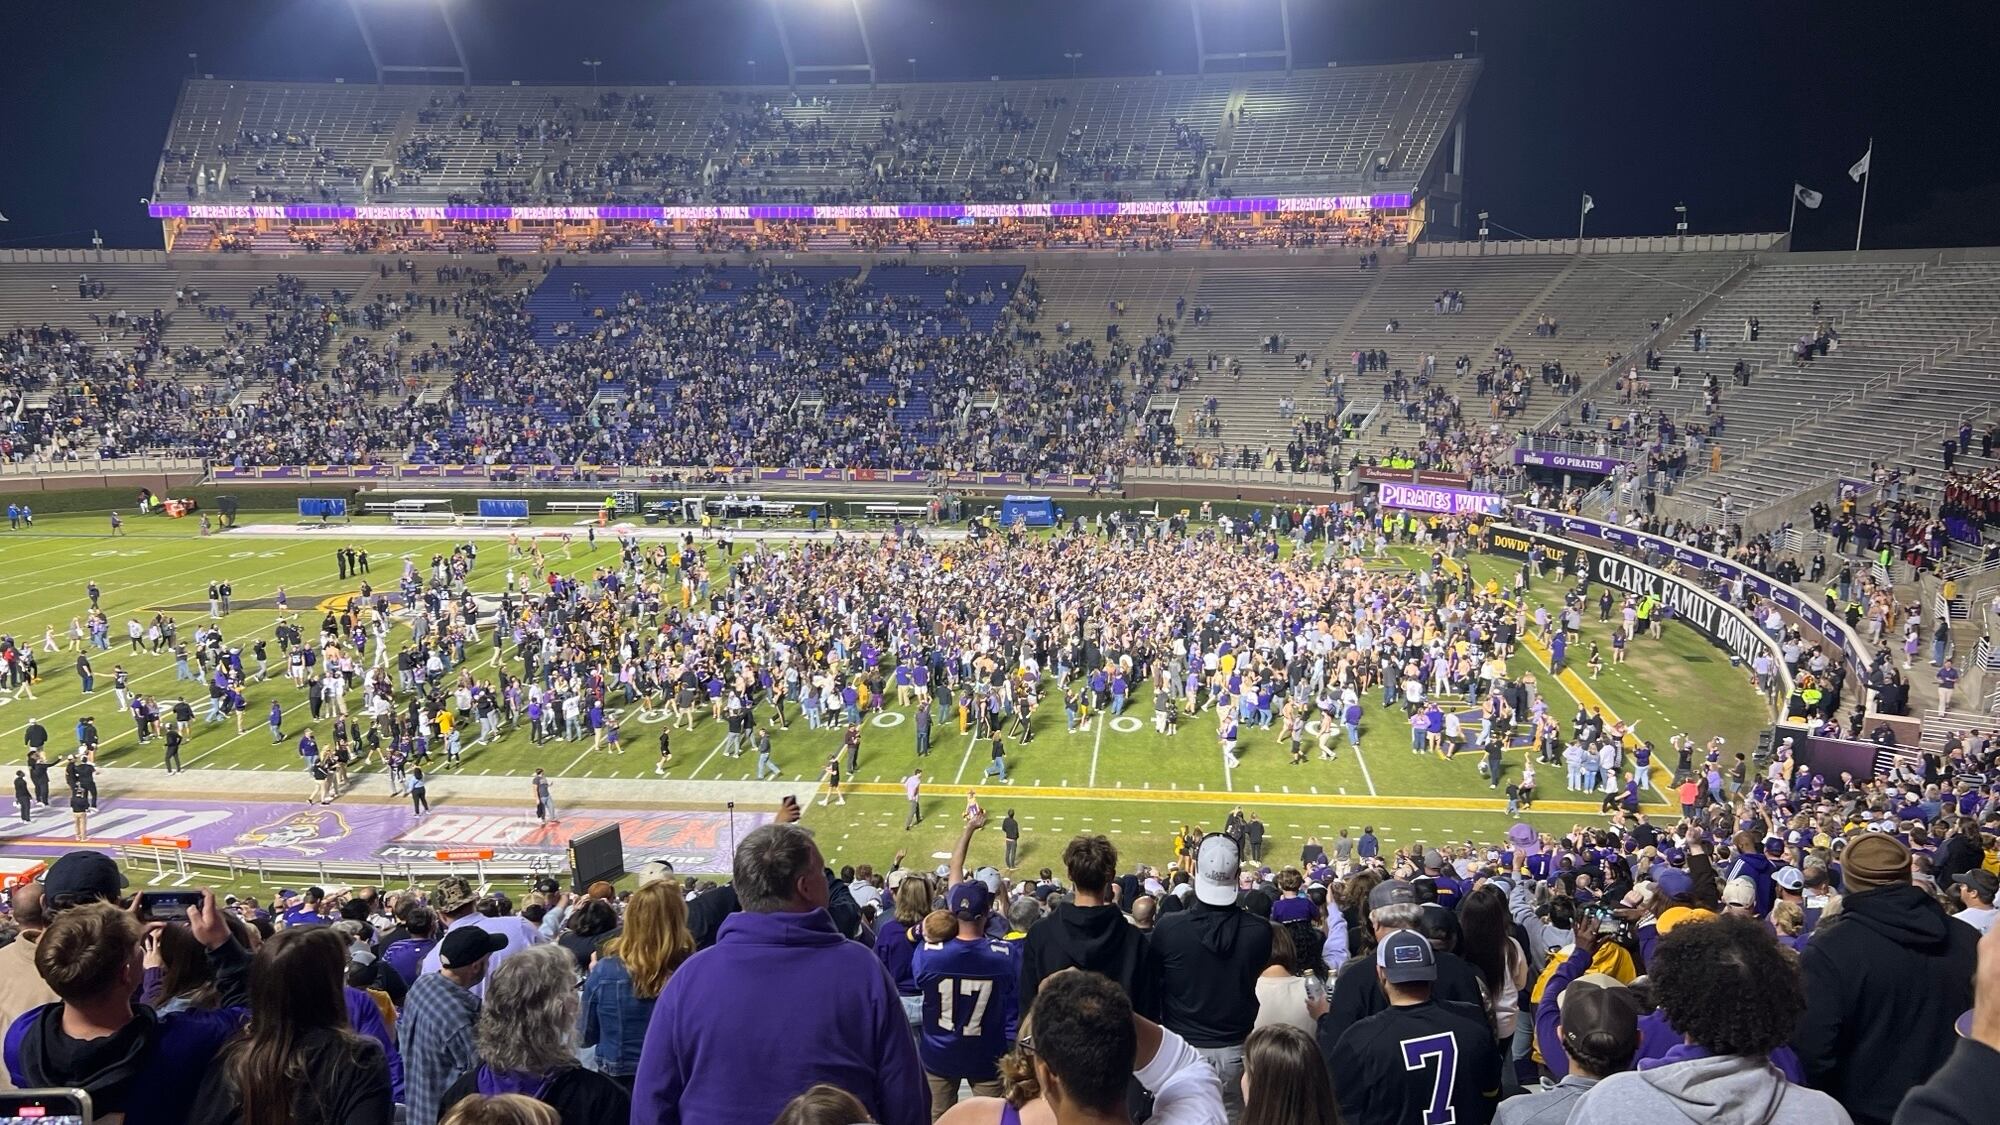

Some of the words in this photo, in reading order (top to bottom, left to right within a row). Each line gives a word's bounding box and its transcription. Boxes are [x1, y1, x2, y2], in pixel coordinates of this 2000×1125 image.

[1118, 201, 1174, 214] PIRATES
[1177, 201, 1207, 214] WIN
[1278, 196, 1336, 210] PIRATES
[1338, 196, 1370, 210] WIN
[188, 205, 251, 218] PIRATES
[252, 205, 285, 218] WIN
[355, 206, 412, 219] PIRATES
[414, 206, 445, 219] WIN
[511, 206, 567, 219] PIRATES
[568, 206, 598, 219] WIN
[664, 206, 717, 219] PIRATES
[719, 206, 748, 219] WIN
[813, 205, 867, 218] PIRATES
[869, 205, 898, 218] WIN
[965, 204, 1019, 217] PIRATES
[1021, 204, 1051, 217] WIN
[1553, 456, 1565, 465] GO
[1567, 457, 1602, 470] PIRATES!
[1380, 483, 1451, 510] PIRATES
[1455, 494, 1499, 514] WIN
[1494, 535, 1530, 553] DOWDY
[1598, 557, 1658, 597] CLARK
[1662, 579, 1717, 632] FAMILY
[1717, 609, 1761, 667] BONEYA
[392, 813, 542, 846] BIG
[938, 978, 993, 1036] 17
[1399, 1031, 1458, 1125] 7
